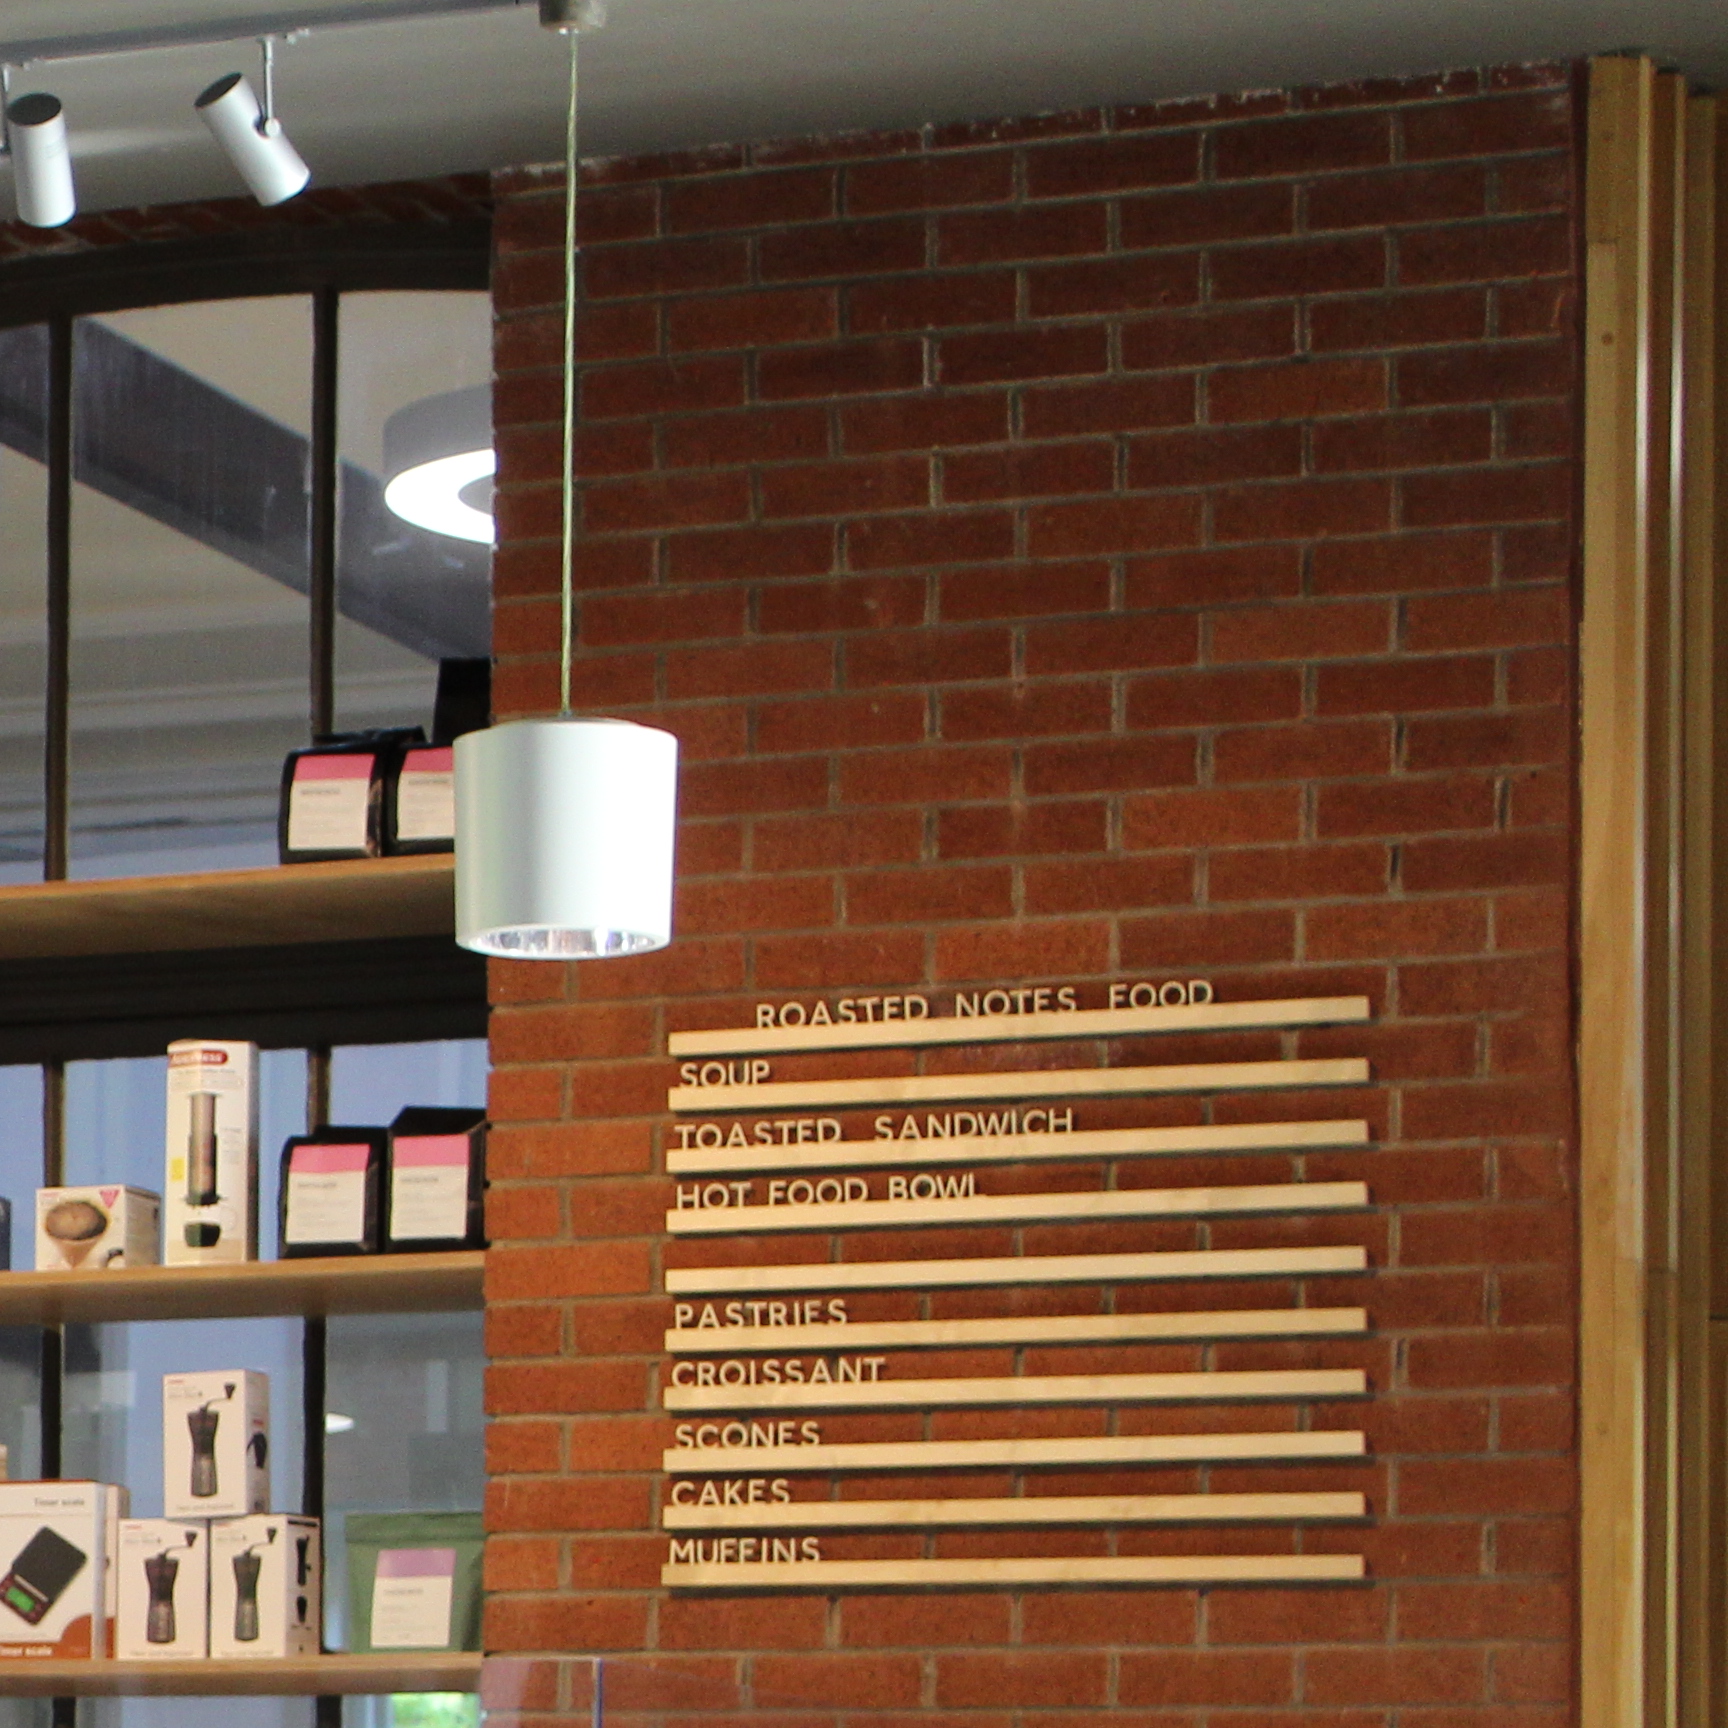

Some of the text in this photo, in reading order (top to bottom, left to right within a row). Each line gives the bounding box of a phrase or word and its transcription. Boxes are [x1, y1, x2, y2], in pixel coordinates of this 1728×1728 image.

[756, 980, 1213, 1030] ROASTED NOTES FOOD
[680, 1060, 771, 1088] SOUP
[674, 1108, 1073, 1151] TOASTED SANDWICH
[676, 1172, 985, 1210] HOT FOOD BOWL
[674, 1300, 848, 1330] PASTRIES
[671, 1357, 886, 1388] CROISSANT
[674, 1421, 820, 1449] SCONES
[671, 1479, 791, 1507] CAKES
[668, 1537, 820, 1566] MUFFINS
